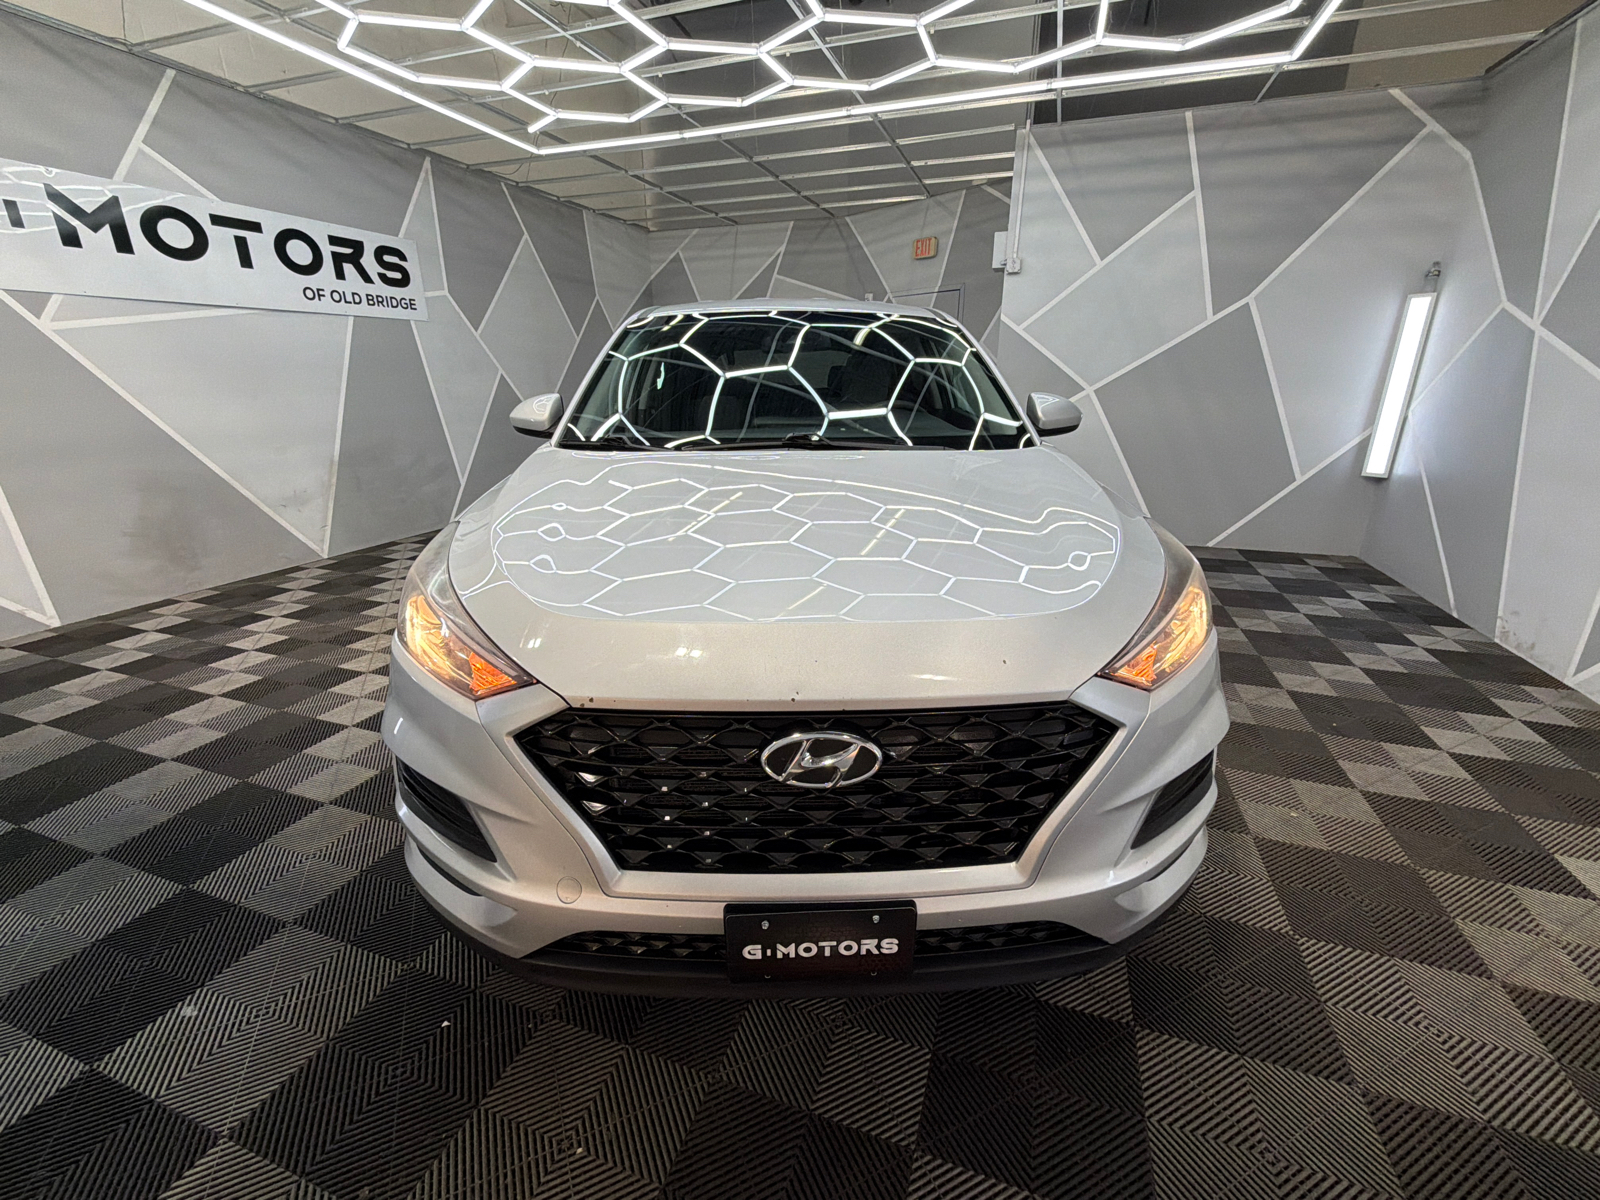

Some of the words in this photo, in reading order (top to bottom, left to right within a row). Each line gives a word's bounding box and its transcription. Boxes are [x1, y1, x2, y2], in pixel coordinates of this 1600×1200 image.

[42, 182, 411, 289] MOTORS
[915, 238, 932, 257] EXIT
[302, 286, 326, 302] OF
[330, 289, 363, 306] OLD
[365, 293, 418, 311] BRIDGE
